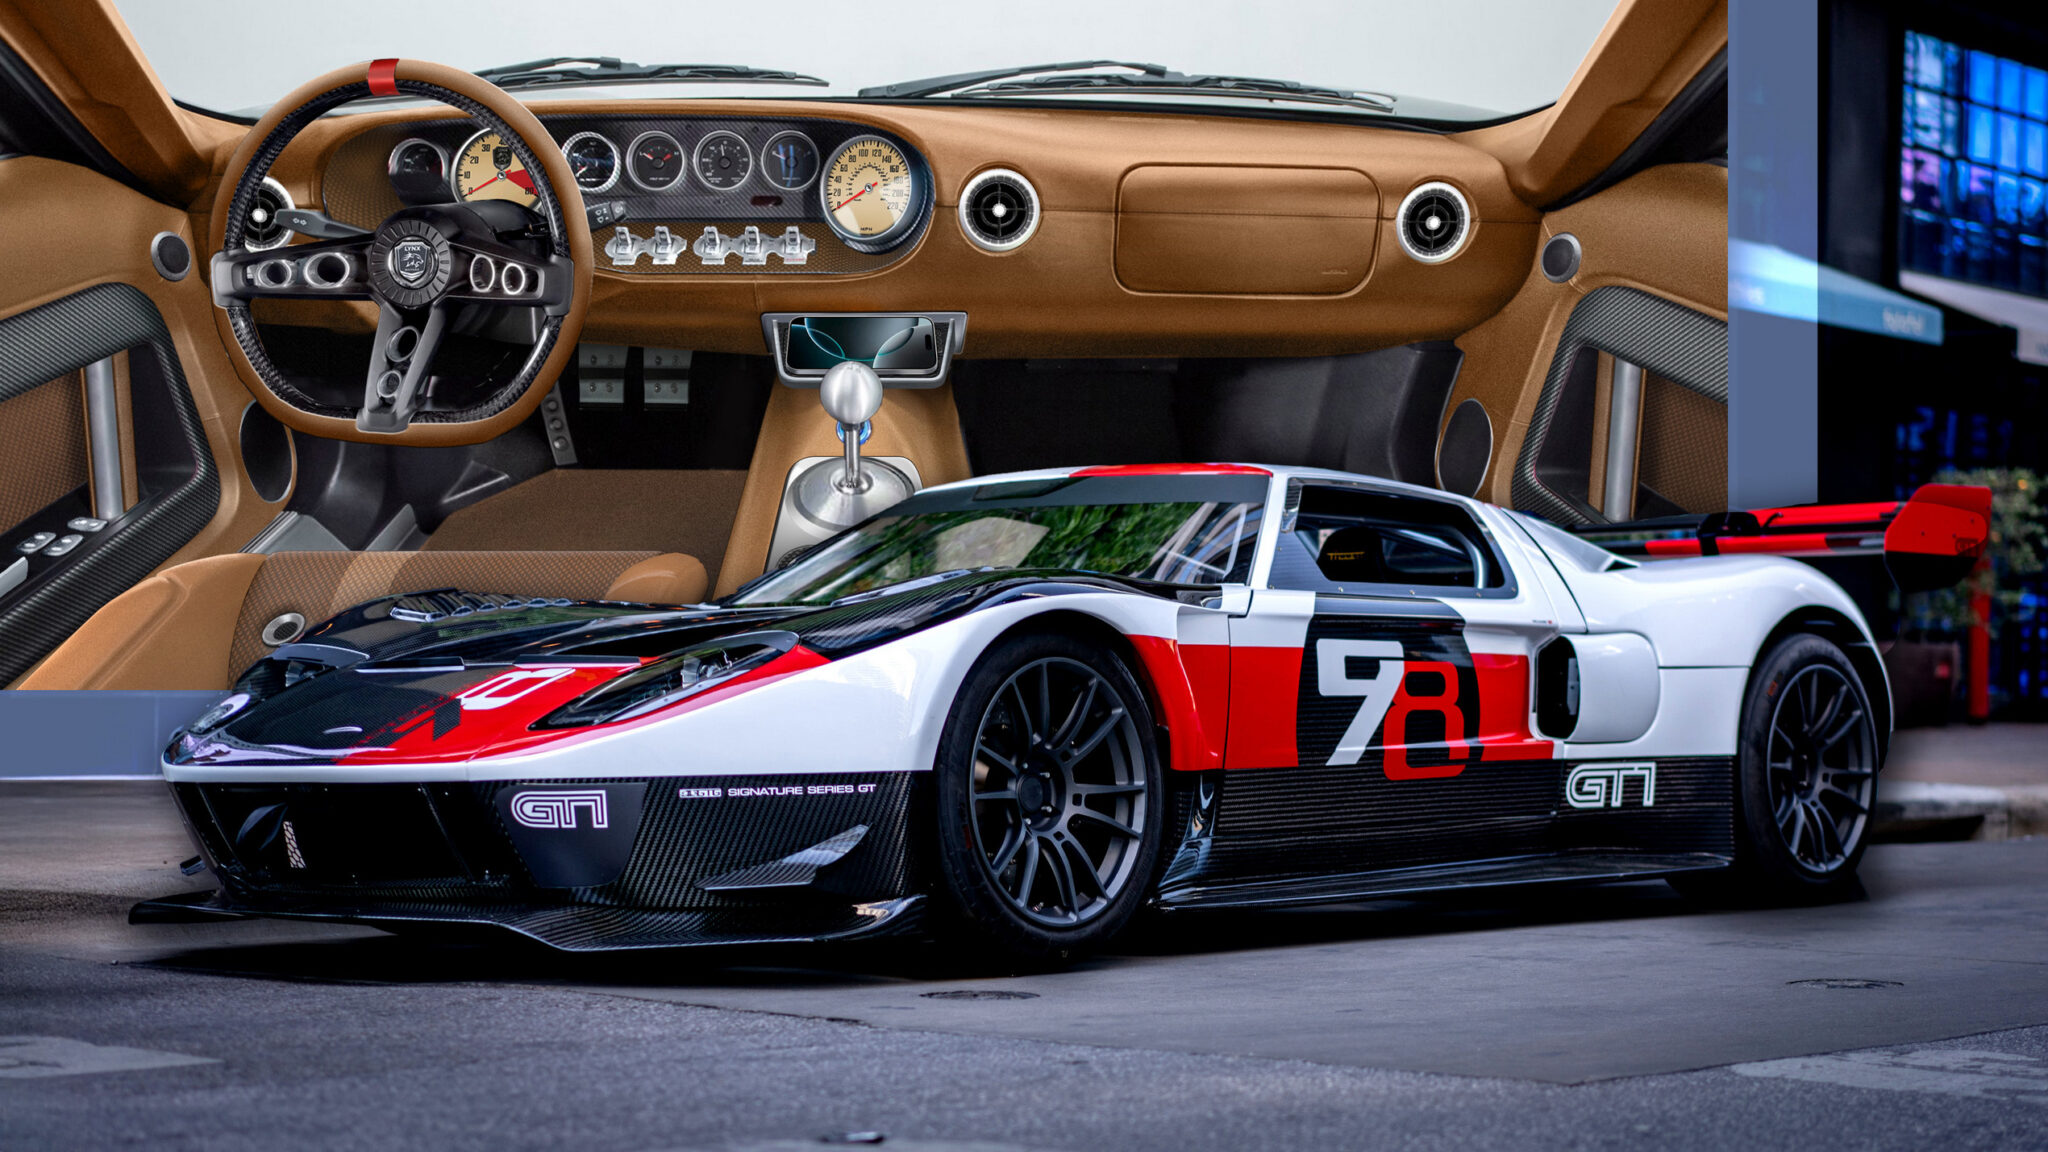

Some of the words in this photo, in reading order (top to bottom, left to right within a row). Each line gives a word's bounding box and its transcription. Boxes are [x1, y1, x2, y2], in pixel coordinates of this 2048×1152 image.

[482, 144, 490, 152] 30
[859, 149, 868, 157] 100
[872, 149, 881, 157] 120
[470, 156, 479, 164] 20
[840, 164, 848, 172] 60
[464, 171, 470, 179] 10
[833, 188, 841, 196] 20
[1316, 638, 1470, 781] 98
[727, 786, 804, 797] SIGNATURE
[807, 784, 854, 795] SERIES
[858, 783, 877, 793] GT
